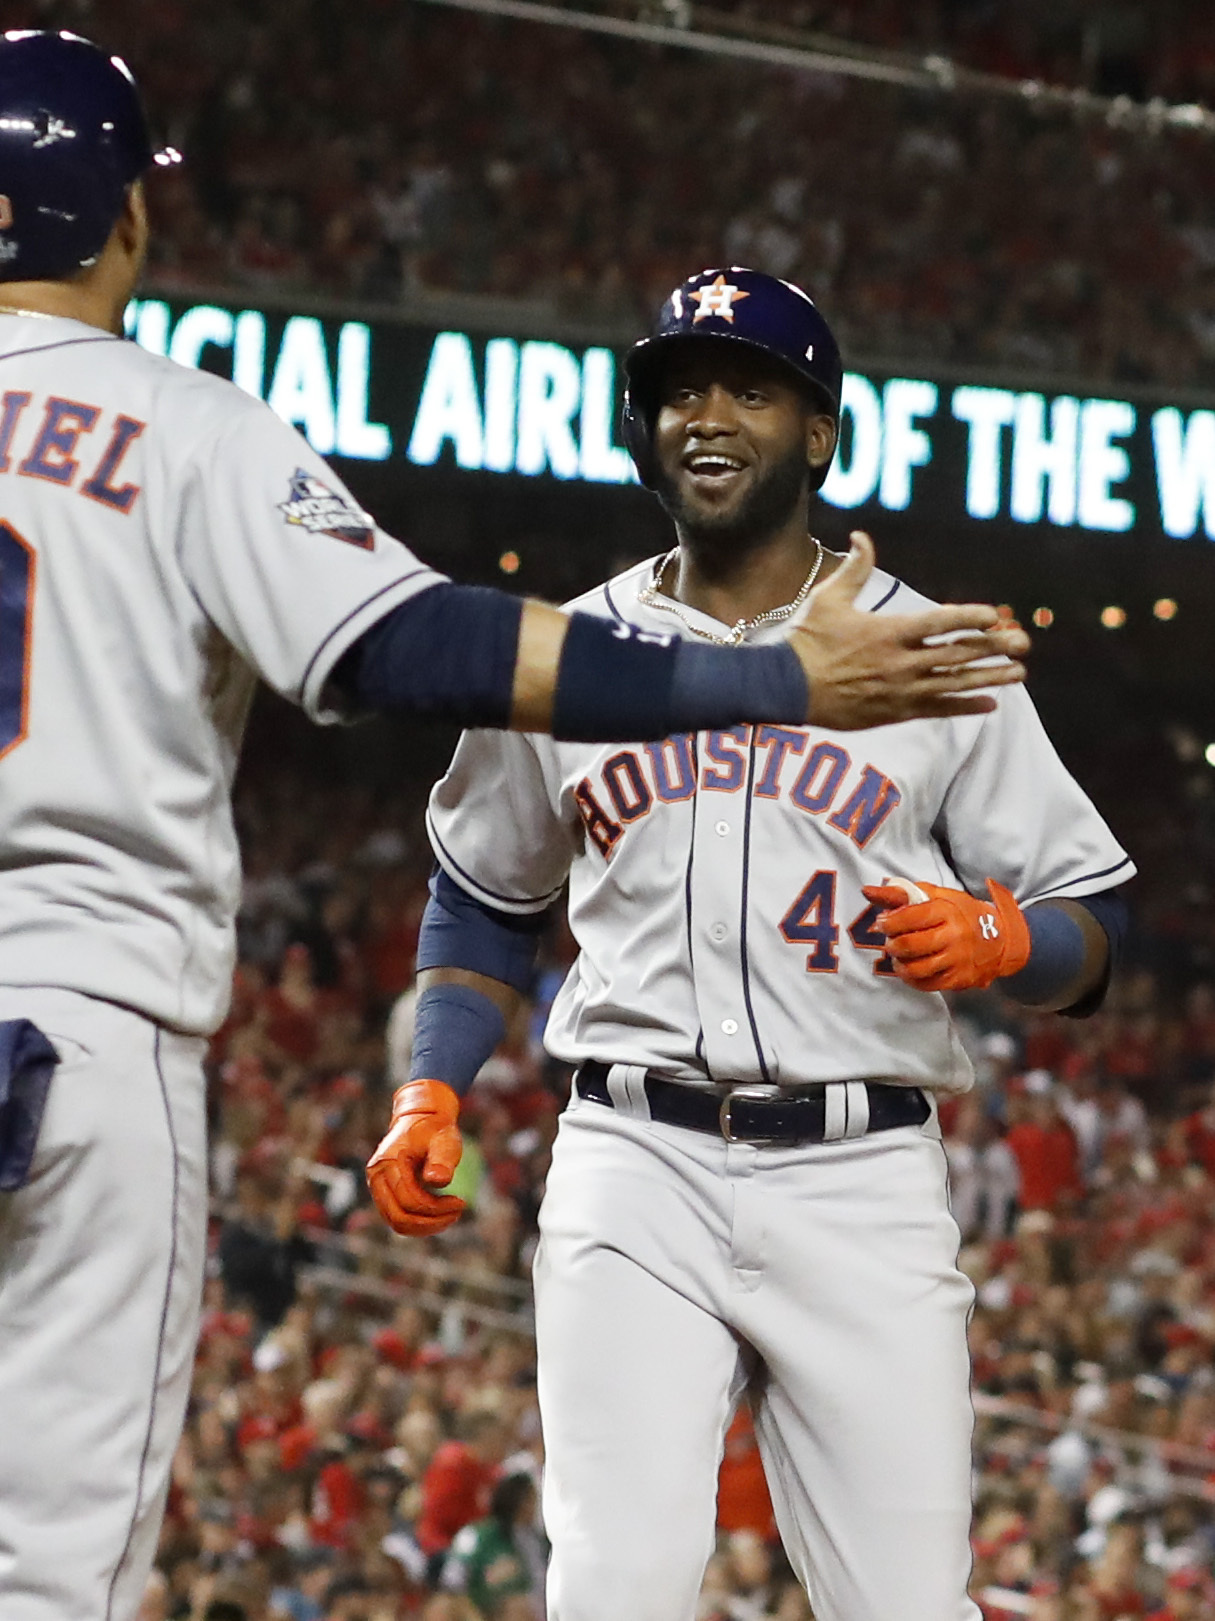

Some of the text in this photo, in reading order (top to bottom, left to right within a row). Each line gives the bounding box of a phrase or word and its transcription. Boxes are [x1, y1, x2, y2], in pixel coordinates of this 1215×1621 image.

[695, 285, 738, 317] H
[123, 298, 391, 460] ICIAL
[407, 331, 641, 485] AIRL
[818, 371, 939, 511] OF
[951, 385, 1137, 533] THE
[574, 723, 901, 860] HOUSTON
